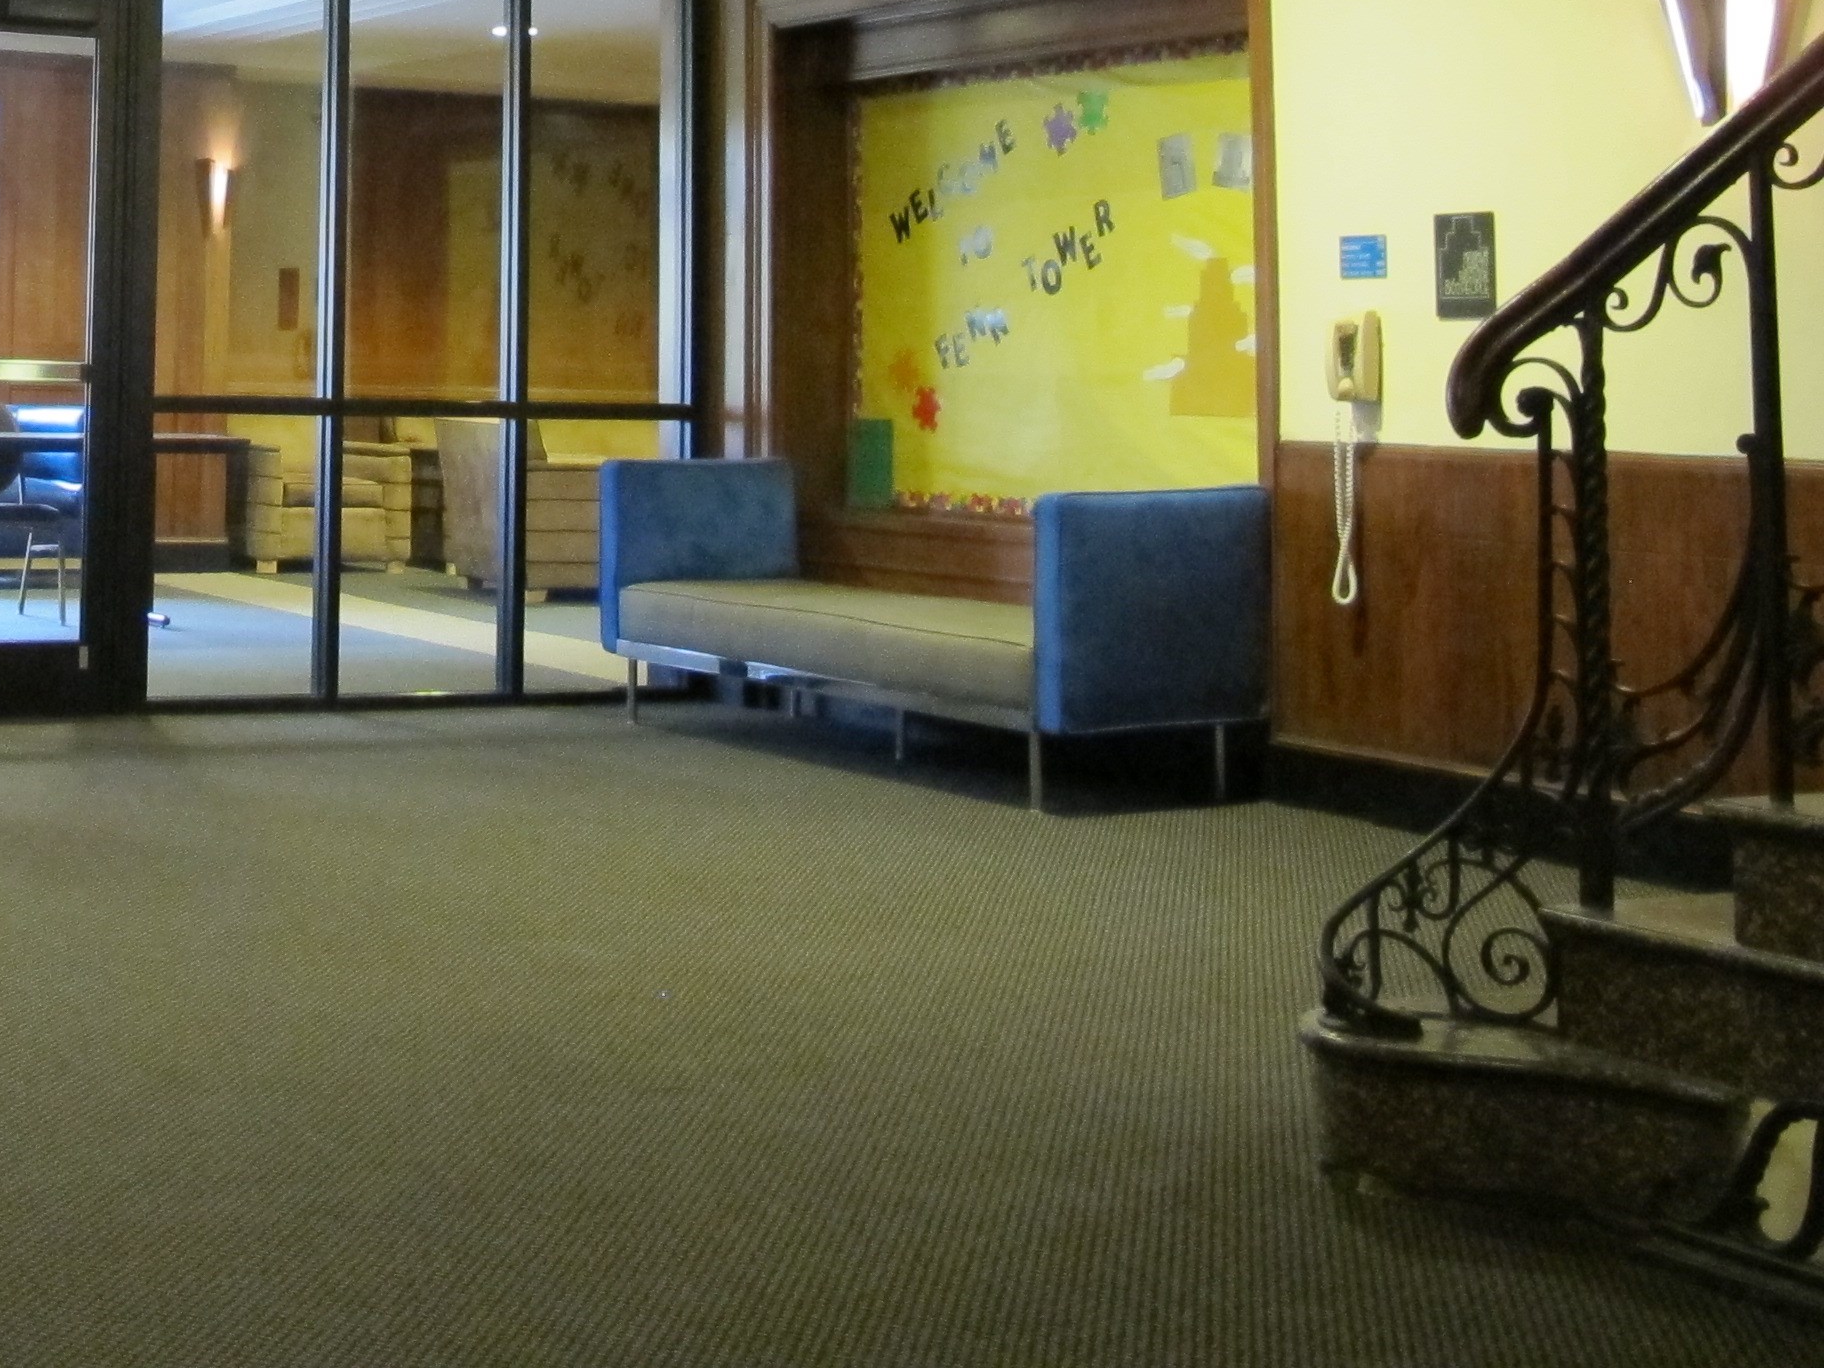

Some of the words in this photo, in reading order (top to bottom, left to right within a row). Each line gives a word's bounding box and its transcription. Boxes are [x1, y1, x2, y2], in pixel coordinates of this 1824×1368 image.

[889, 119, 1016, 244] WELCOME
[934, 306, 1010, 370] FENN
[1021, 199, 1115, 296] TOWER
